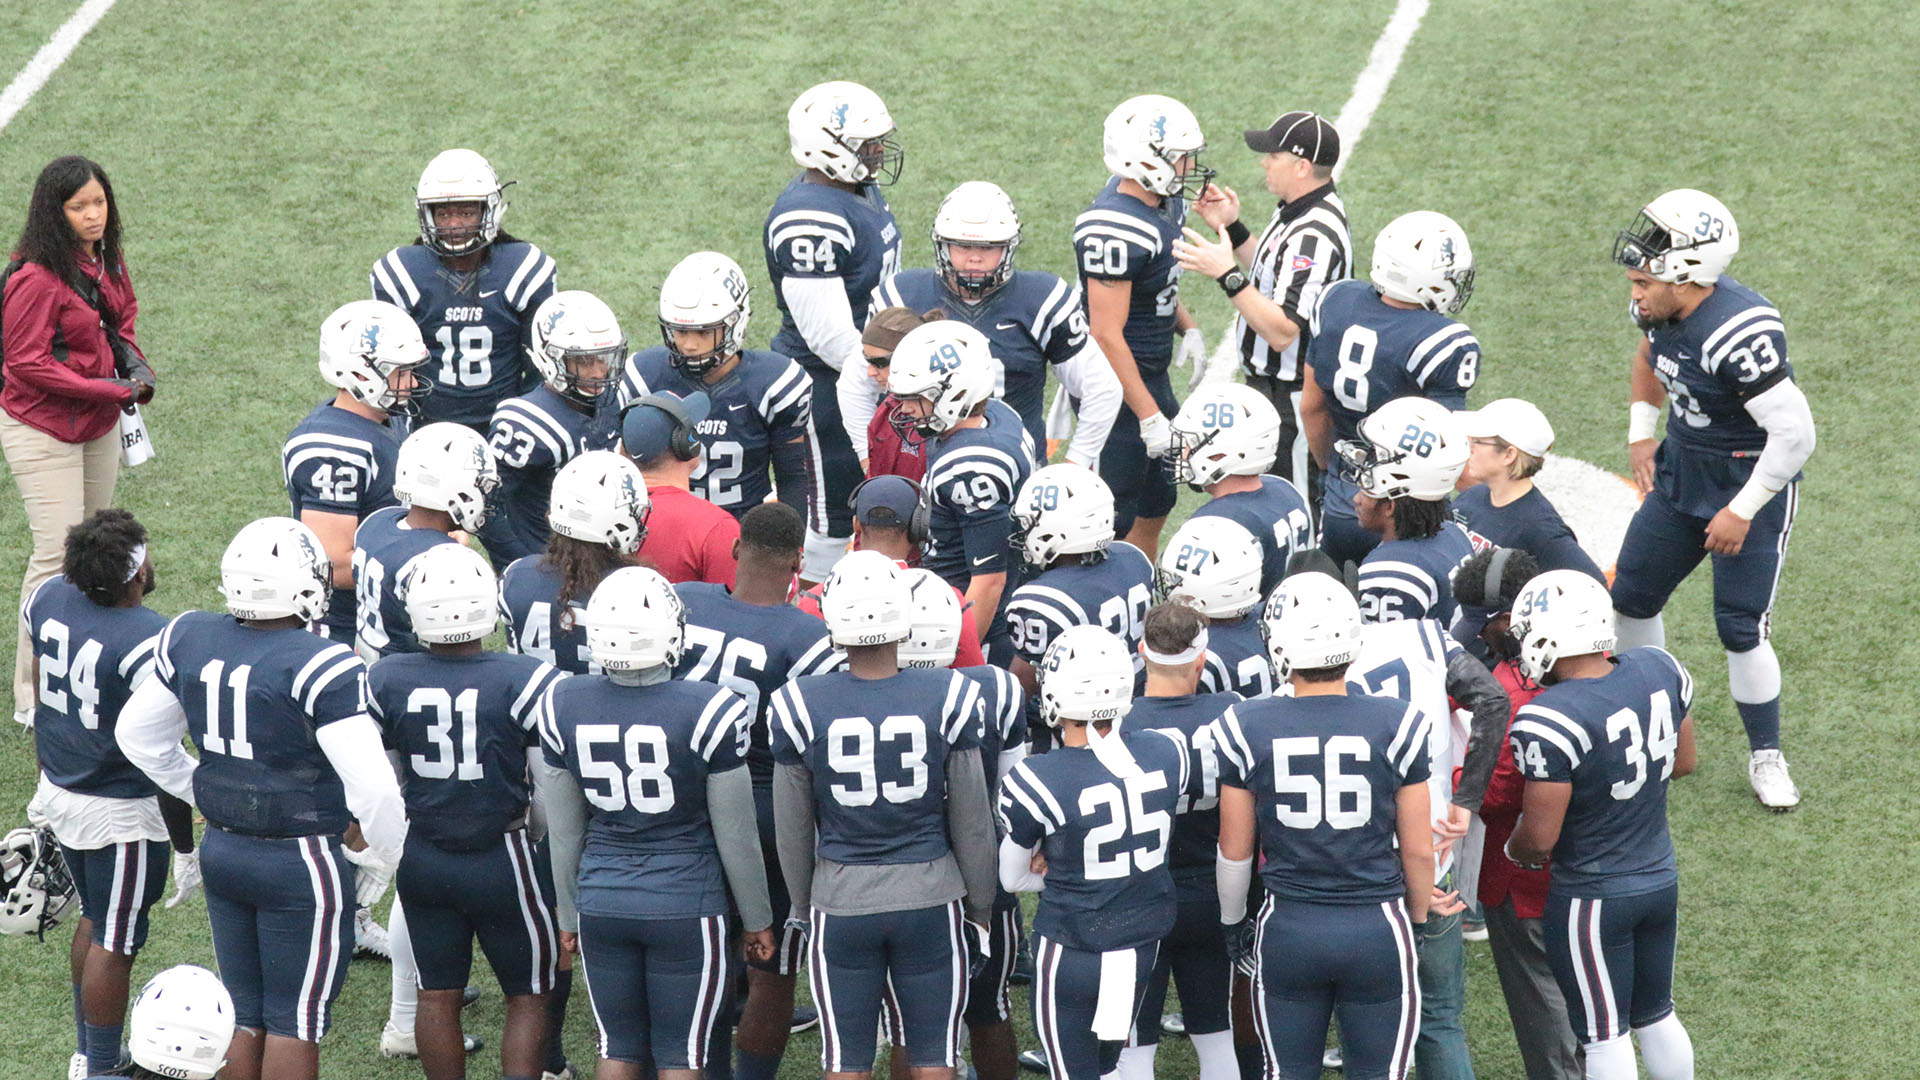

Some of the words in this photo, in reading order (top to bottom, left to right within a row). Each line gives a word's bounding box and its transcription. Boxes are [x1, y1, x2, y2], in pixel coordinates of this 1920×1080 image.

[1694, 211, 1724, 240] 33
[791, 237, 837, 272] 94
[1083, 236, 1128, 275] 20
[723, 268, 745, 303] 22
[445, 306, 483, 322] SCOTS
[435, 325, 493, 387] 18
[929, 343, 962, 375] 49
[1333, 324, 1378, 412] 8
[1456, 350, 1478, 388] 8
[1656, 353, 1680, 378] SCOTS
[1729, 334, 1780, 383] 33
[694, 419, 728, 435] COTS
[1202, 403, 1234, 428] 36
[488, 421, 536, 469] 23
[1398, 424, 1437, 459] 26
[311, 463, 359, 502] 42
[950, 475, 1001, 514] 49
[1030, 484, 1059, 511] 39
[1175, 544, 1210, 576] 27
[233, 608, 257, 620] SCOTS
[1266, 594, 1287, 620] 56
[1360, 593, 1403, 623] 26
[1518, 588, 1549, 617] 34
[443, 631, 472, 643] SCOTS
[858, 633, 888, 645] SCOTS
[1006, 612, 1048, 655] 39
[1592, 638, 1613, 651] SCOTS
[39, 617, 103, 730] 24
[603, 658, 631, 669] SCOTS
[683, 623, 768, 727] 76
[908, 658, 937, 669] SCOTS
[1324, 651, 1352, 666] SCOTS
[200, 658, 254, 760] 11
[1091, 707, 1119, 719] SCOTS
[407, 687, 484, 781] 31
[1606, 688, 1678, 801] 34
[575, 724, 676, 814] 58
[827, 715, 929, 807] 93
[1508, 736, 1550, 778] 34
[1272, 735, 1372, 830] 56
[1077, 769, 1172, 880] 25
[157, 1063, 190, 1079] SCOTS
